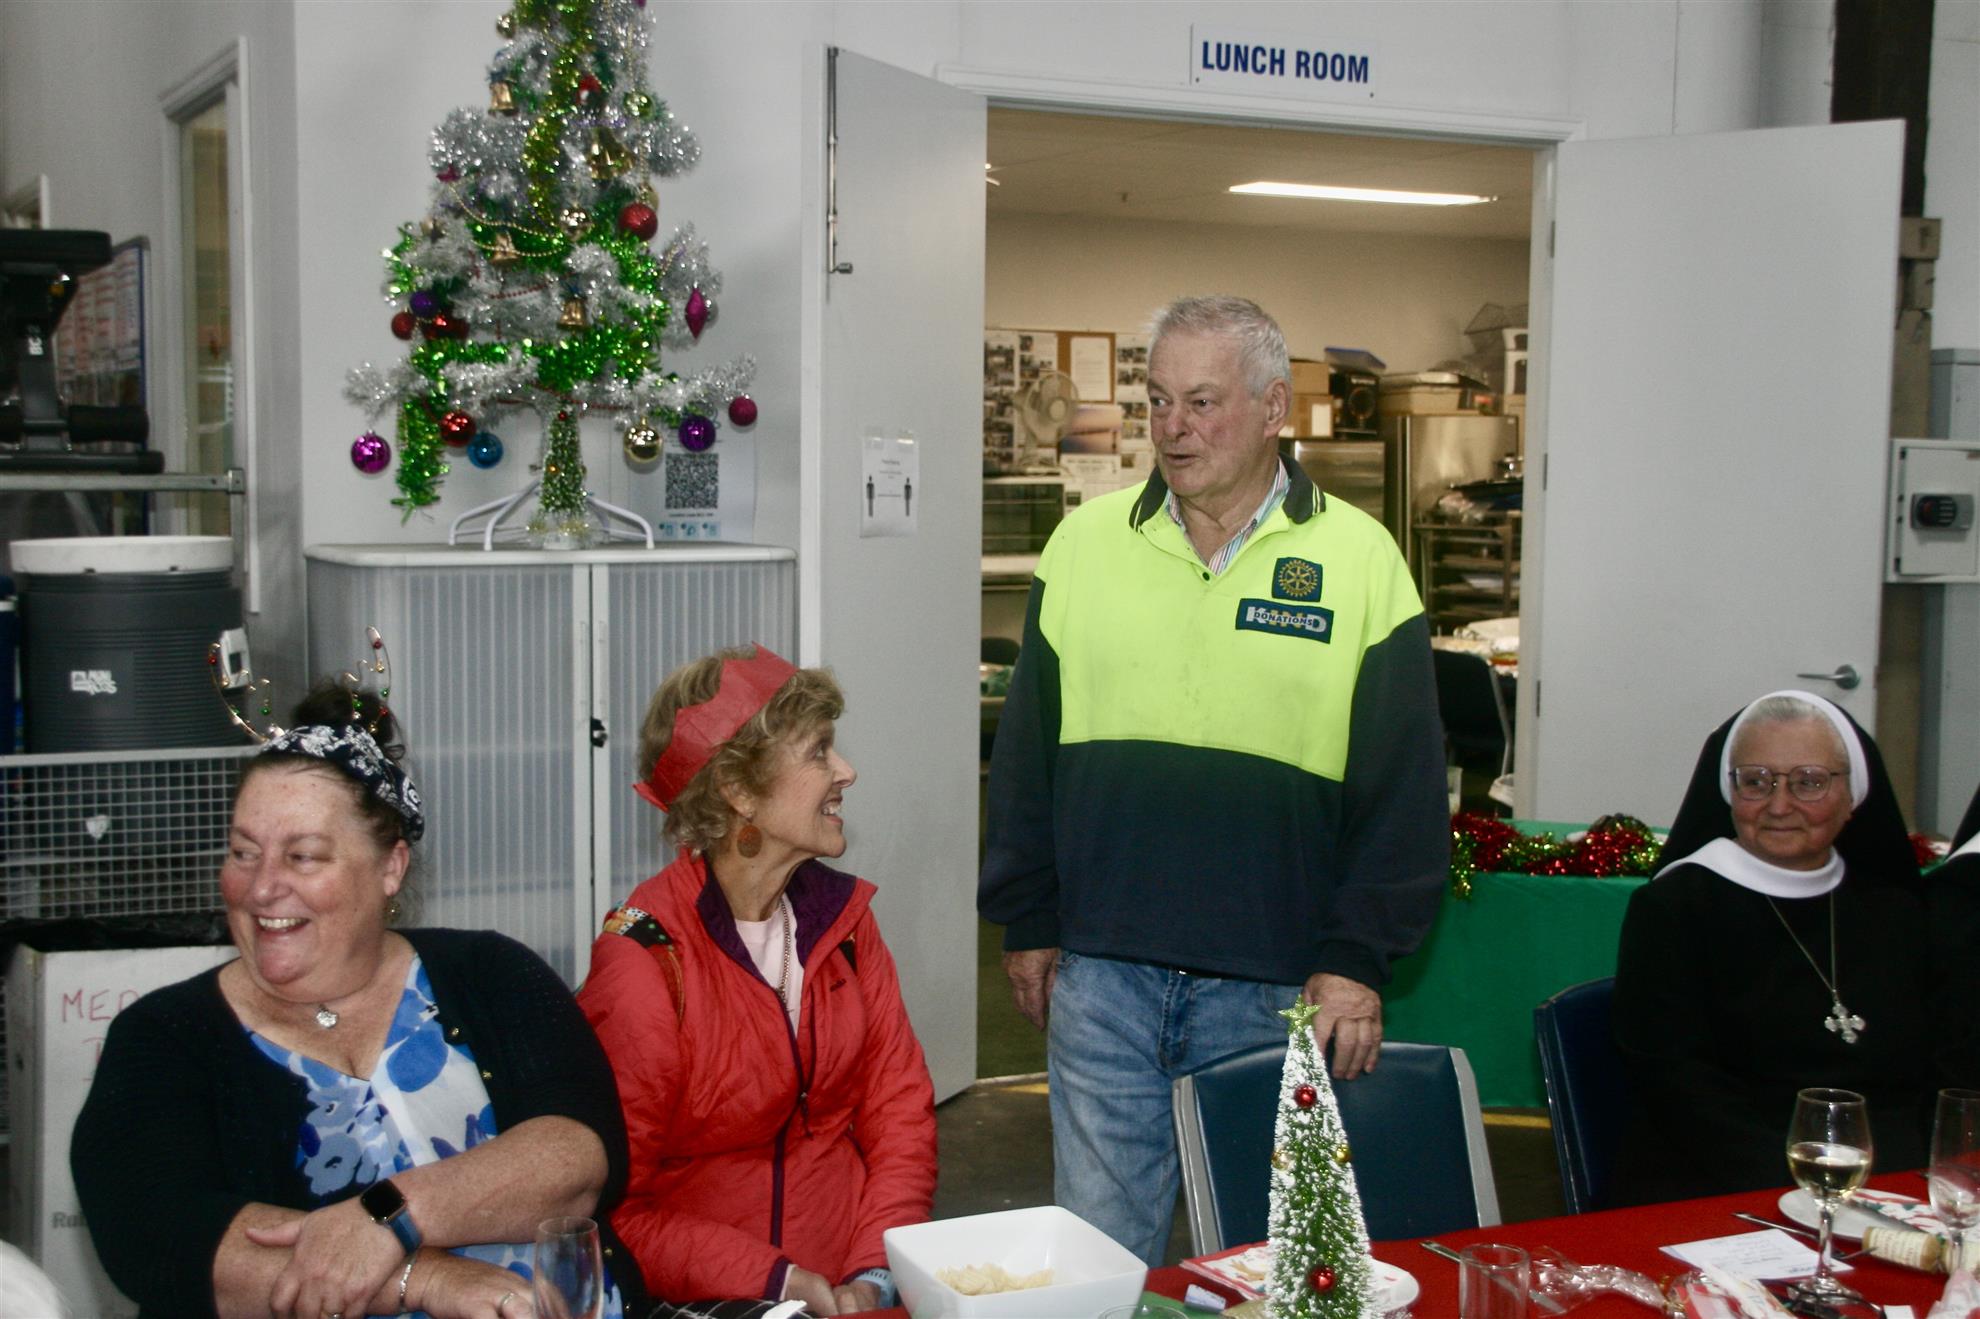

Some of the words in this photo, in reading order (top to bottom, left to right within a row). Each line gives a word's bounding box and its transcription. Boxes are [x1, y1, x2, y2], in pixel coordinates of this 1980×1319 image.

[1202, 41, 1285, 76] LUNCH
[1295, 50, 1368, 84] ROOM
[1254, 611, 1313, 626] DONATIONS
